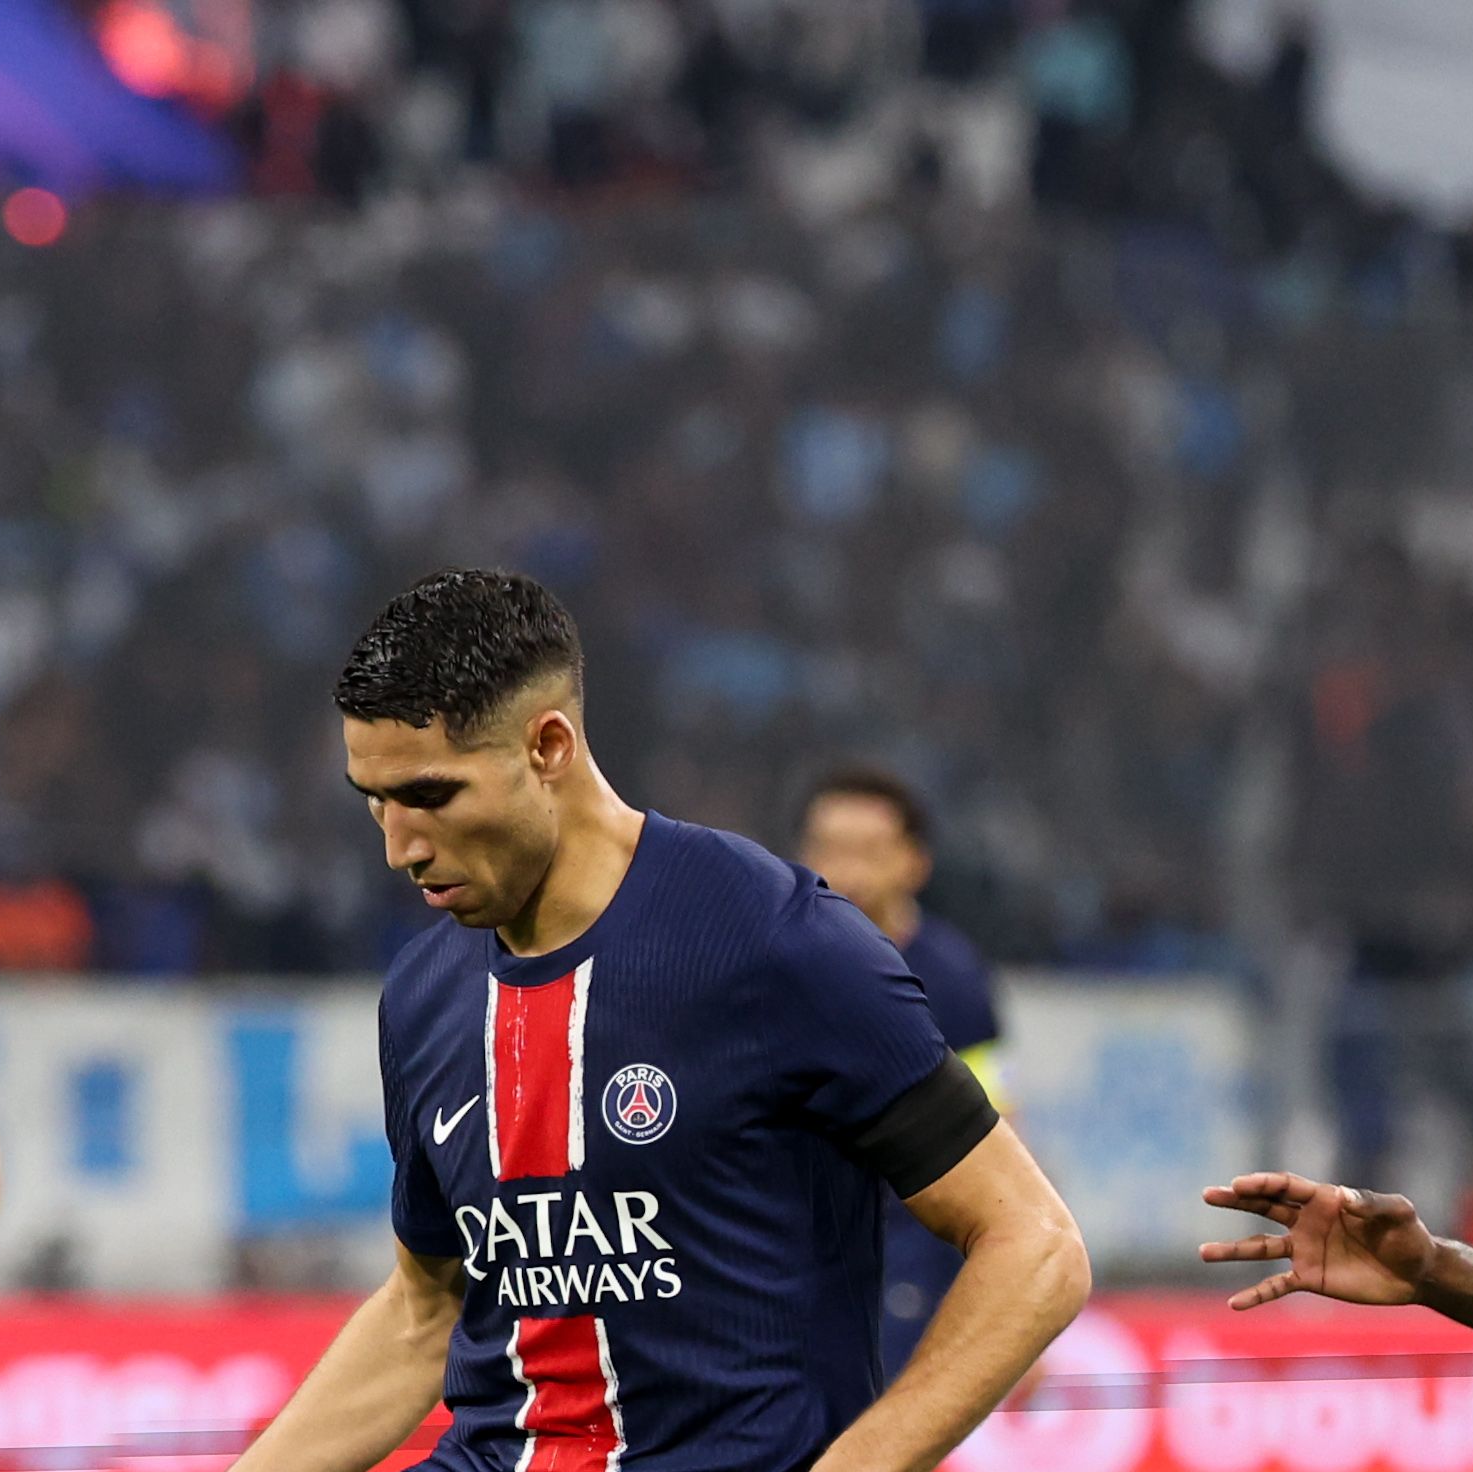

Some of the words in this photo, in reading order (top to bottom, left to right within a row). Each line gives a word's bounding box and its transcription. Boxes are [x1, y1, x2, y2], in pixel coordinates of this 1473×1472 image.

[615, 1067, 665, 1088] PARIS
[454, 1190, 674, 1282] QATAR
[497, 1257, 682, 1307] AIRWAYS
